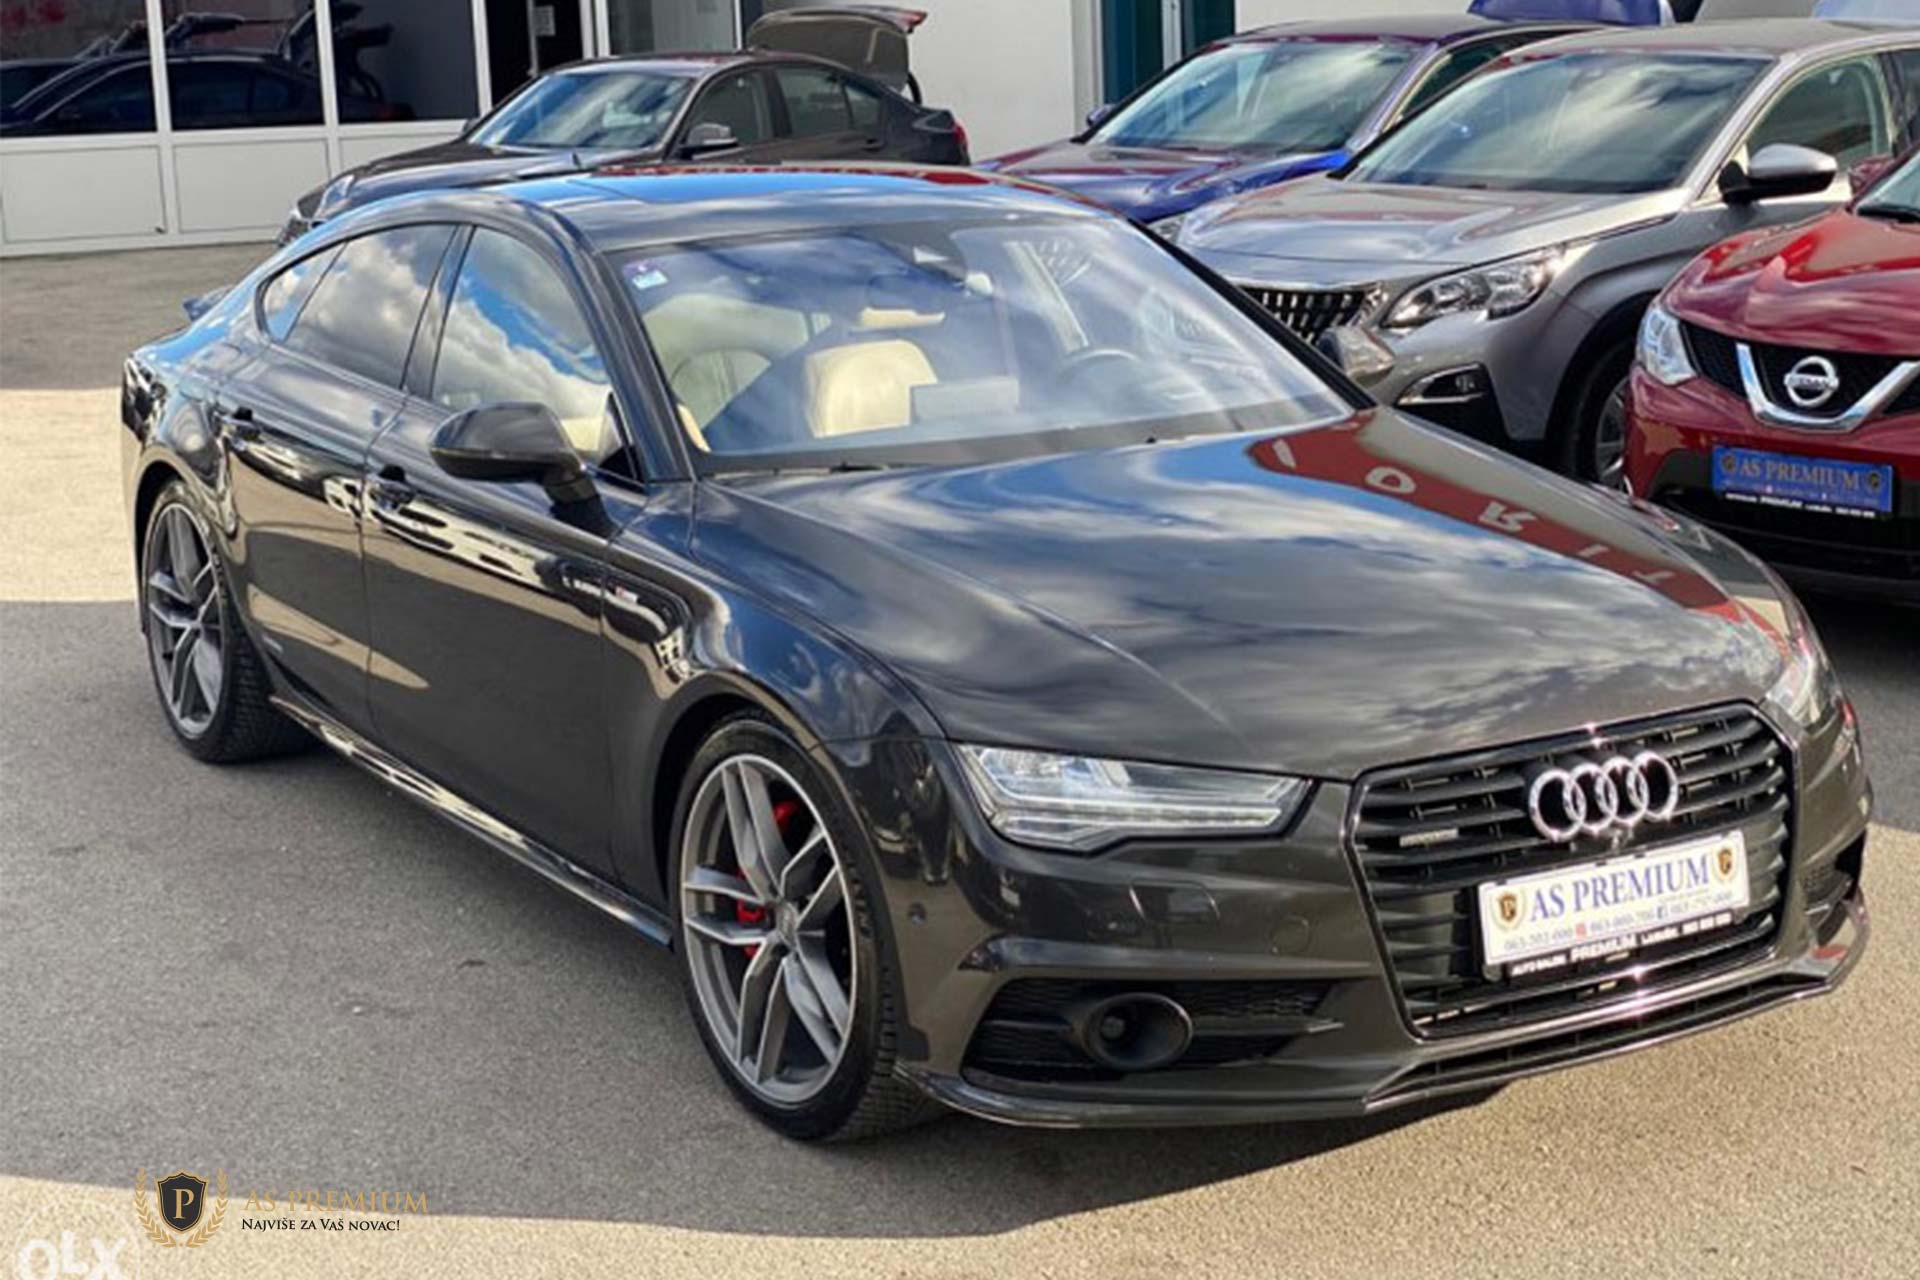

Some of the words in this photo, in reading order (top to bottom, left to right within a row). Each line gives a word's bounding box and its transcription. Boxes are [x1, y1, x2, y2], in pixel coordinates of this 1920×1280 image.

[1740, 458, 1760, 476] AS
[1765, 460, 1860, 490] PREMIUM
[1531, 883, 1565, 921] AS
[1573, 854, 1711, 912] PREMIUM
